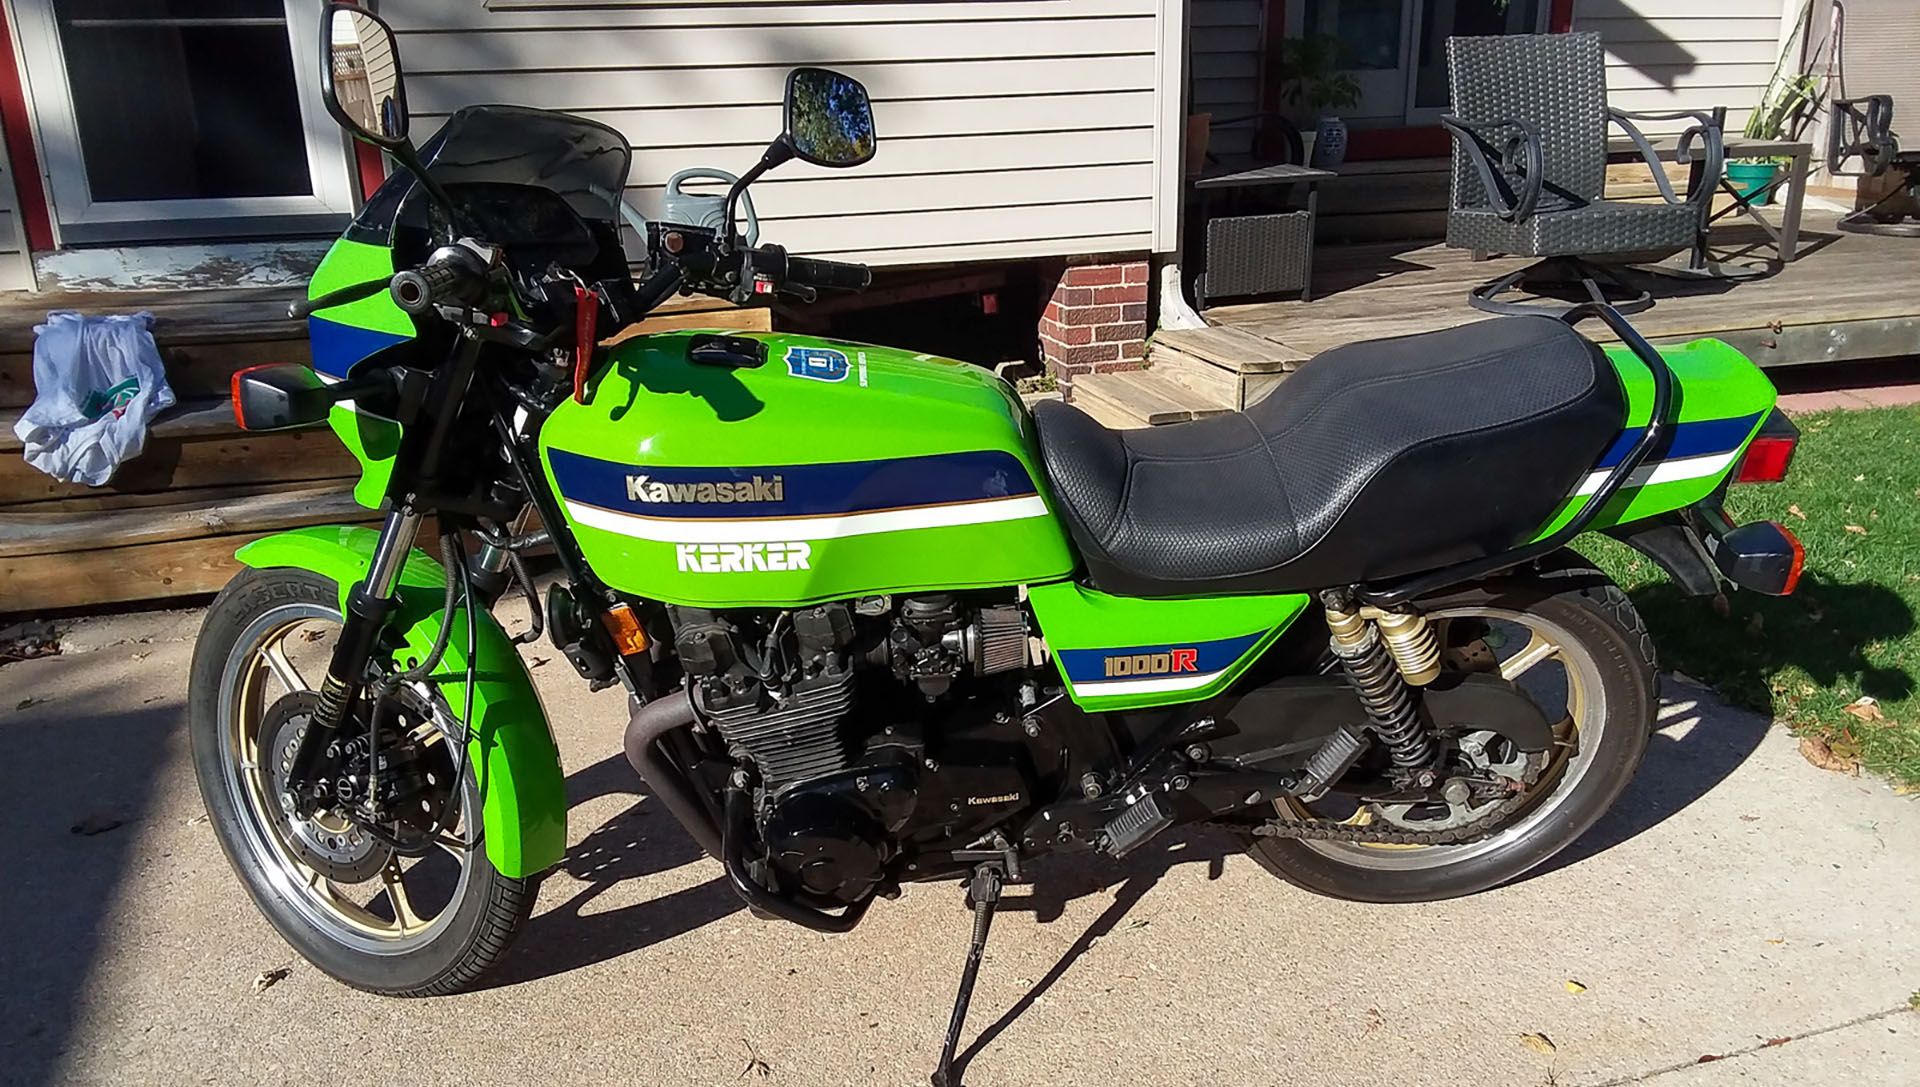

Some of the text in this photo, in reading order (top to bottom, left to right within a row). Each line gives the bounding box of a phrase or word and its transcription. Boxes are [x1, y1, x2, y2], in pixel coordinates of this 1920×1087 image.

[626, 475, 784, 503] Kawasaki
[676, 543, 812, 573] KERKER
[1104, 648, 1199, 677] 1000R
[967, 792, 1020, 806] Kawasaki
